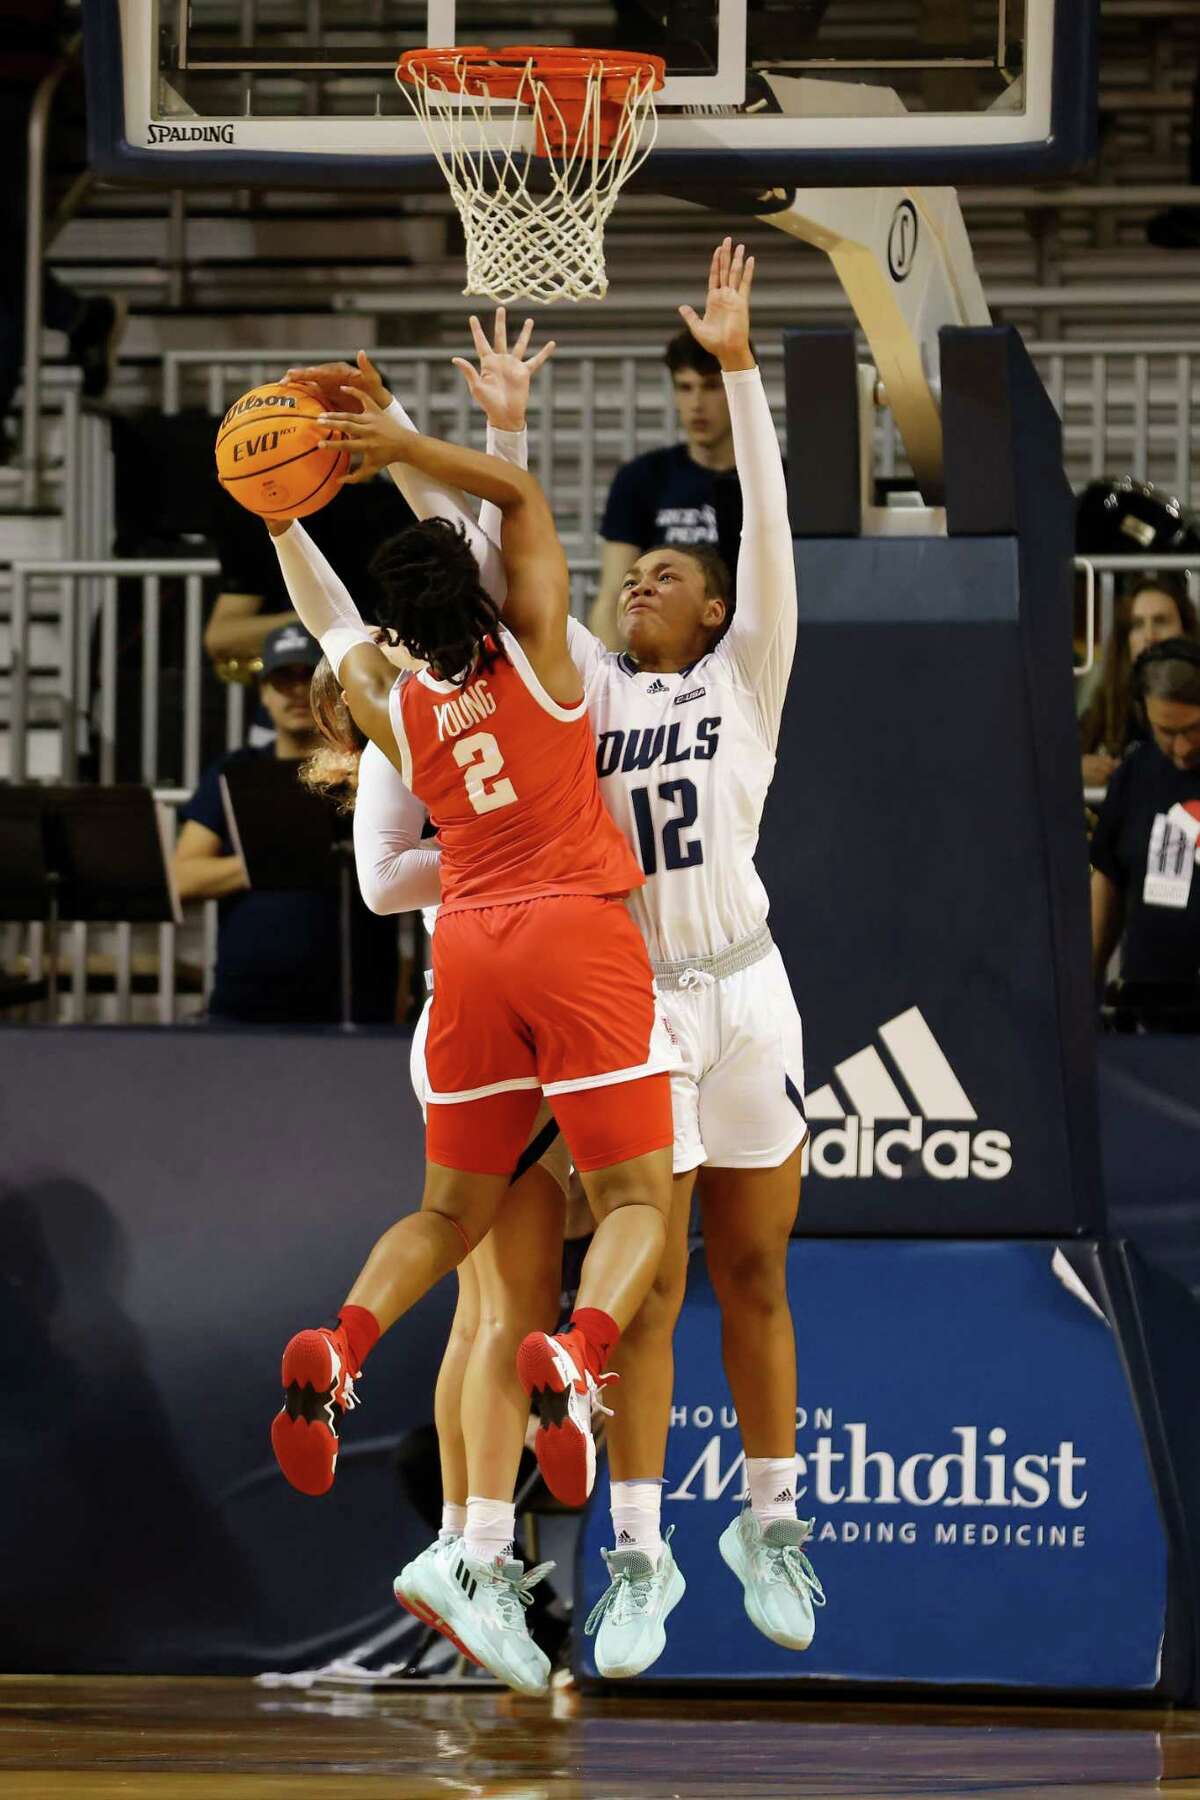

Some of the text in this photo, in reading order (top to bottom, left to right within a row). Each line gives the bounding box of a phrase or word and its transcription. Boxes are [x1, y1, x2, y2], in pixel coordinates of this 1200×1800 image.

[147, 124, 235, 145] SPALDING
[433, 679, 497, 742] YOUNG
[452, 731, 519, 815] 2
[596, 716, 722, 778] OWLS
[631, 778, 704, 875] 12
[801, 1114, 1013, 1180] didas
[670, 1405, 833, 1430] HOUON
[666, 1423, 1088, 1509] Mthodist
[935, 1523, 1087, 1546] MEDICINE
